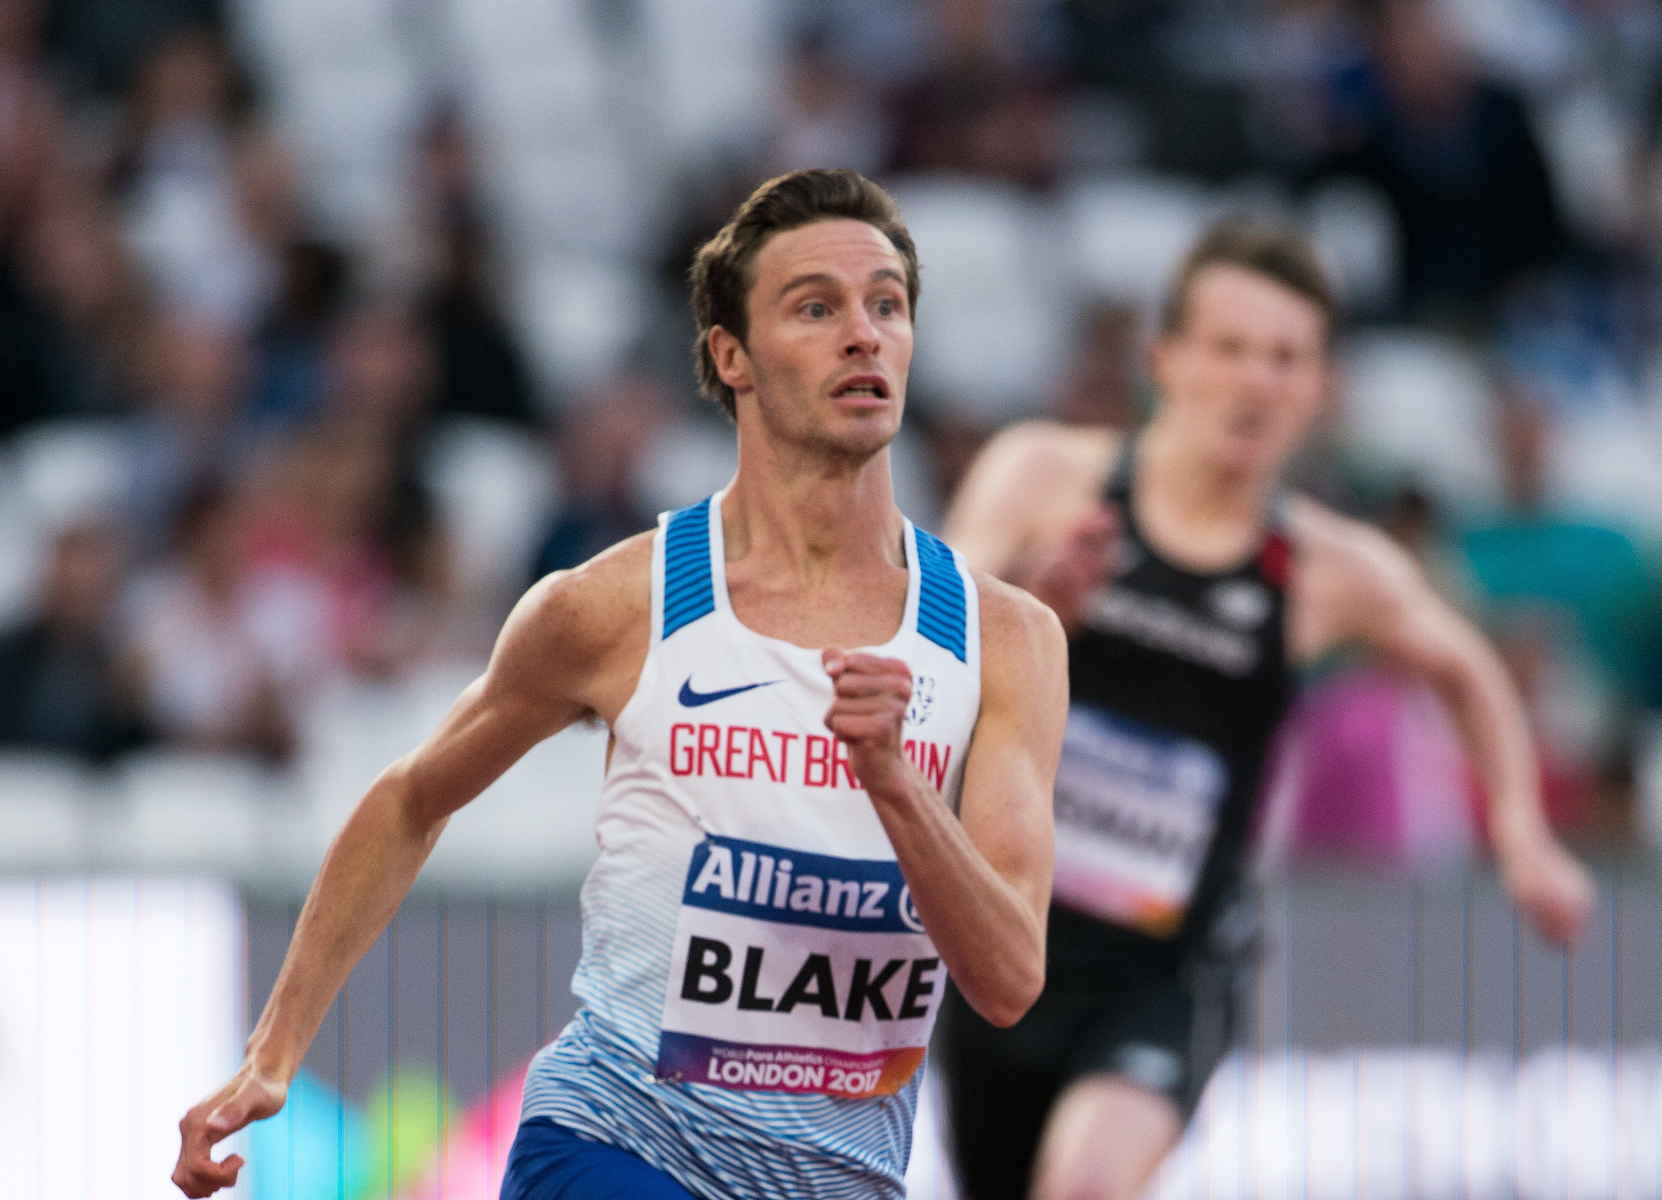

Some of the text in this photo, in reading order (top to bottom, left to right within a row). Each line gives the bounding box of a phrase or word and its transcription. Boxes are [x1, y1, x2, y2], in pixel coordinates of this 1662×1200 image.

[670, 723, 952, 793] GREAT BRIN
[692, 845, 889, 918] Allianz
[680, 935, 940, 1023] BLAKE
[708, 1057, 882, 1094] LONDON 2017
